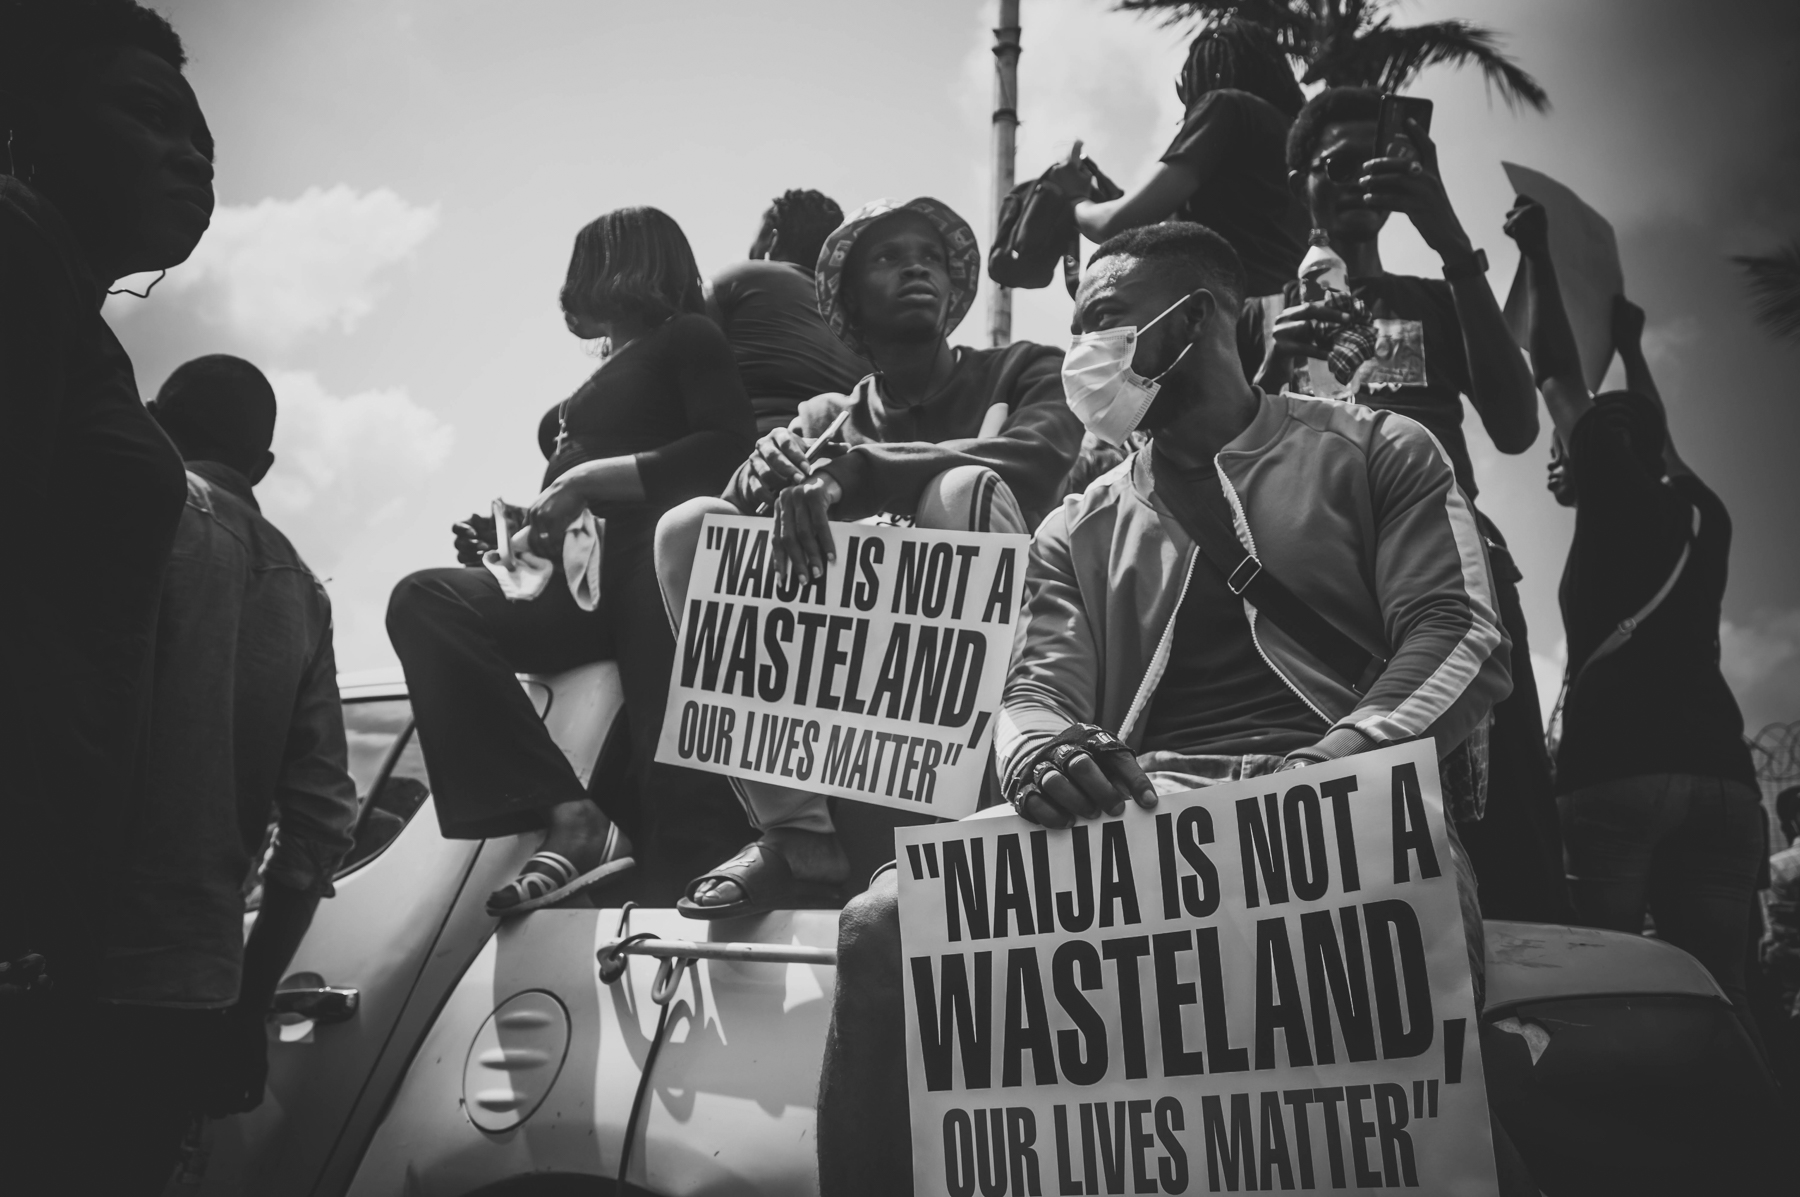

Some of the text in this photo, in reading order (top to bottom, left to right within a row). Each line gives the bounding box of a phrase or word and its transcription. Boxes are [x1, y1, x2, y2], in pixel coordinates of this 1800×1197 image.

[840, 535, 885, 611] IS
[891, 540, 980, 620] NOT
[981, 547, 1016, 624] A
[680, 598, 992, 750] WASTELAND,
[677, 700, 963, 804] OUR LIVES MATTER"
[906, 762, 1442, 942] "NAIJA IS NOT A
[910, 898, 1467, 1092] WASTELAND,
[942, 1079, 1439, 1197] OUR LIVES MATTER"
